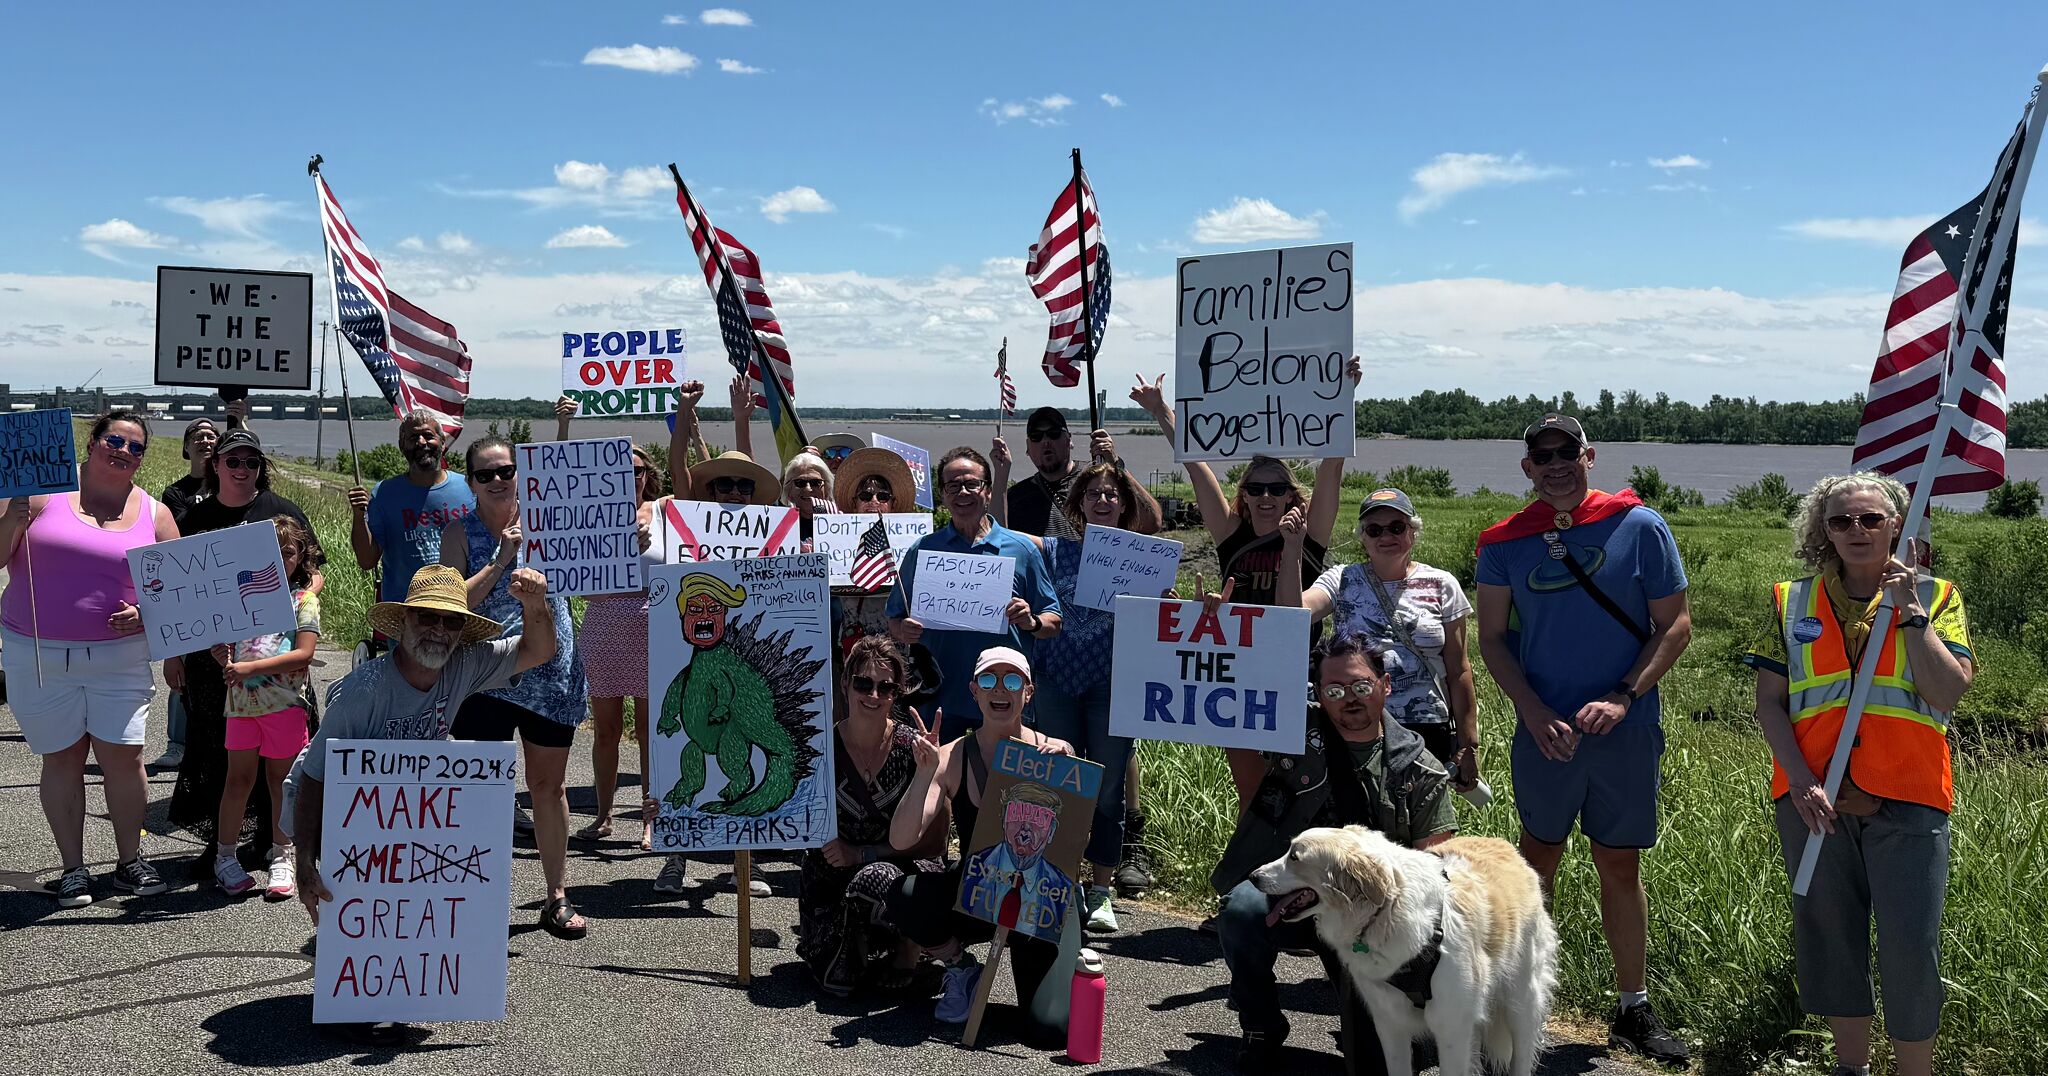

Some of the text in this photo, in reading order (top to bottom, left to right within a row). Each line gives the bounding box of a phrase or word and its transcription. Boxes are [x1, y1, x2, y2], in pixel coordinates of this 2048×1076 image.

[210, 282, 260, 306] WE
[196, 314, 270, 340] THE
[563, 329, 684, 358] PEOPLE
[177, 346, 290, 372] PEOPLE
[580, 358, 676, 386] OVER
[1199, 326, 1344, 400] Belong
[4, 411, 68, 429] INJUSTICE
[40, 425, 68, 446] LAW
[521, 440, 632, 470] TRAITOR
[36, 463, 72, 484] DUTY
[527, 470, 633, 501] RAPIST
[402, 502, 469, 529] Resist
[528, 502, 638, 532] UNEDUCATED
[706, 510, 770, 538] IRAN
[906, 522, 927, 535] me
[404, 530, 428, 541] Like
[526, 532, 638, 563] MISOGYNISTIC
[1092, 532, 1178, 558] THIS ALL ENDS
[168, 541, 235, 574] WE
[732, 556, 826, 572] PROTECT OUR
[926, 556, 1002, 579] FASCISM
[1086, 552, 1160, 578] WHEN ENOUGH
[538, 563, 638, 594] EDOPHILE
[742, 570, 775, 582] PARKS
[783, 568, 826, 578] ANIMALS
[751, 581, 784, 592] FROM
[961, 582, 981, 590] NOT
[1112, 576, 1131, 587] SAY
[169, 578, 232, 603] THE
[160, 608, 264, 646] PEOPLE
[1157, 602, 1265, 648] EAT
[1176, 650, 1235, 683] THE
[1143, 682, 1278, 731] RICH
[1001, 745, 1081, 792] Elect A
[342, 785, 462, 830] MAKE
[653, 816, 719, 834] PROTECT
[726, 805, 810, 844] PARKS!
[664, 831, 705, 847] OUR
[333, 842, 491, 883] AMERICA
[1037, 877, 1068, 904] Get
[338, 897, 465, 939] GREAT
[333, 953, 460, 998] AGAIN
